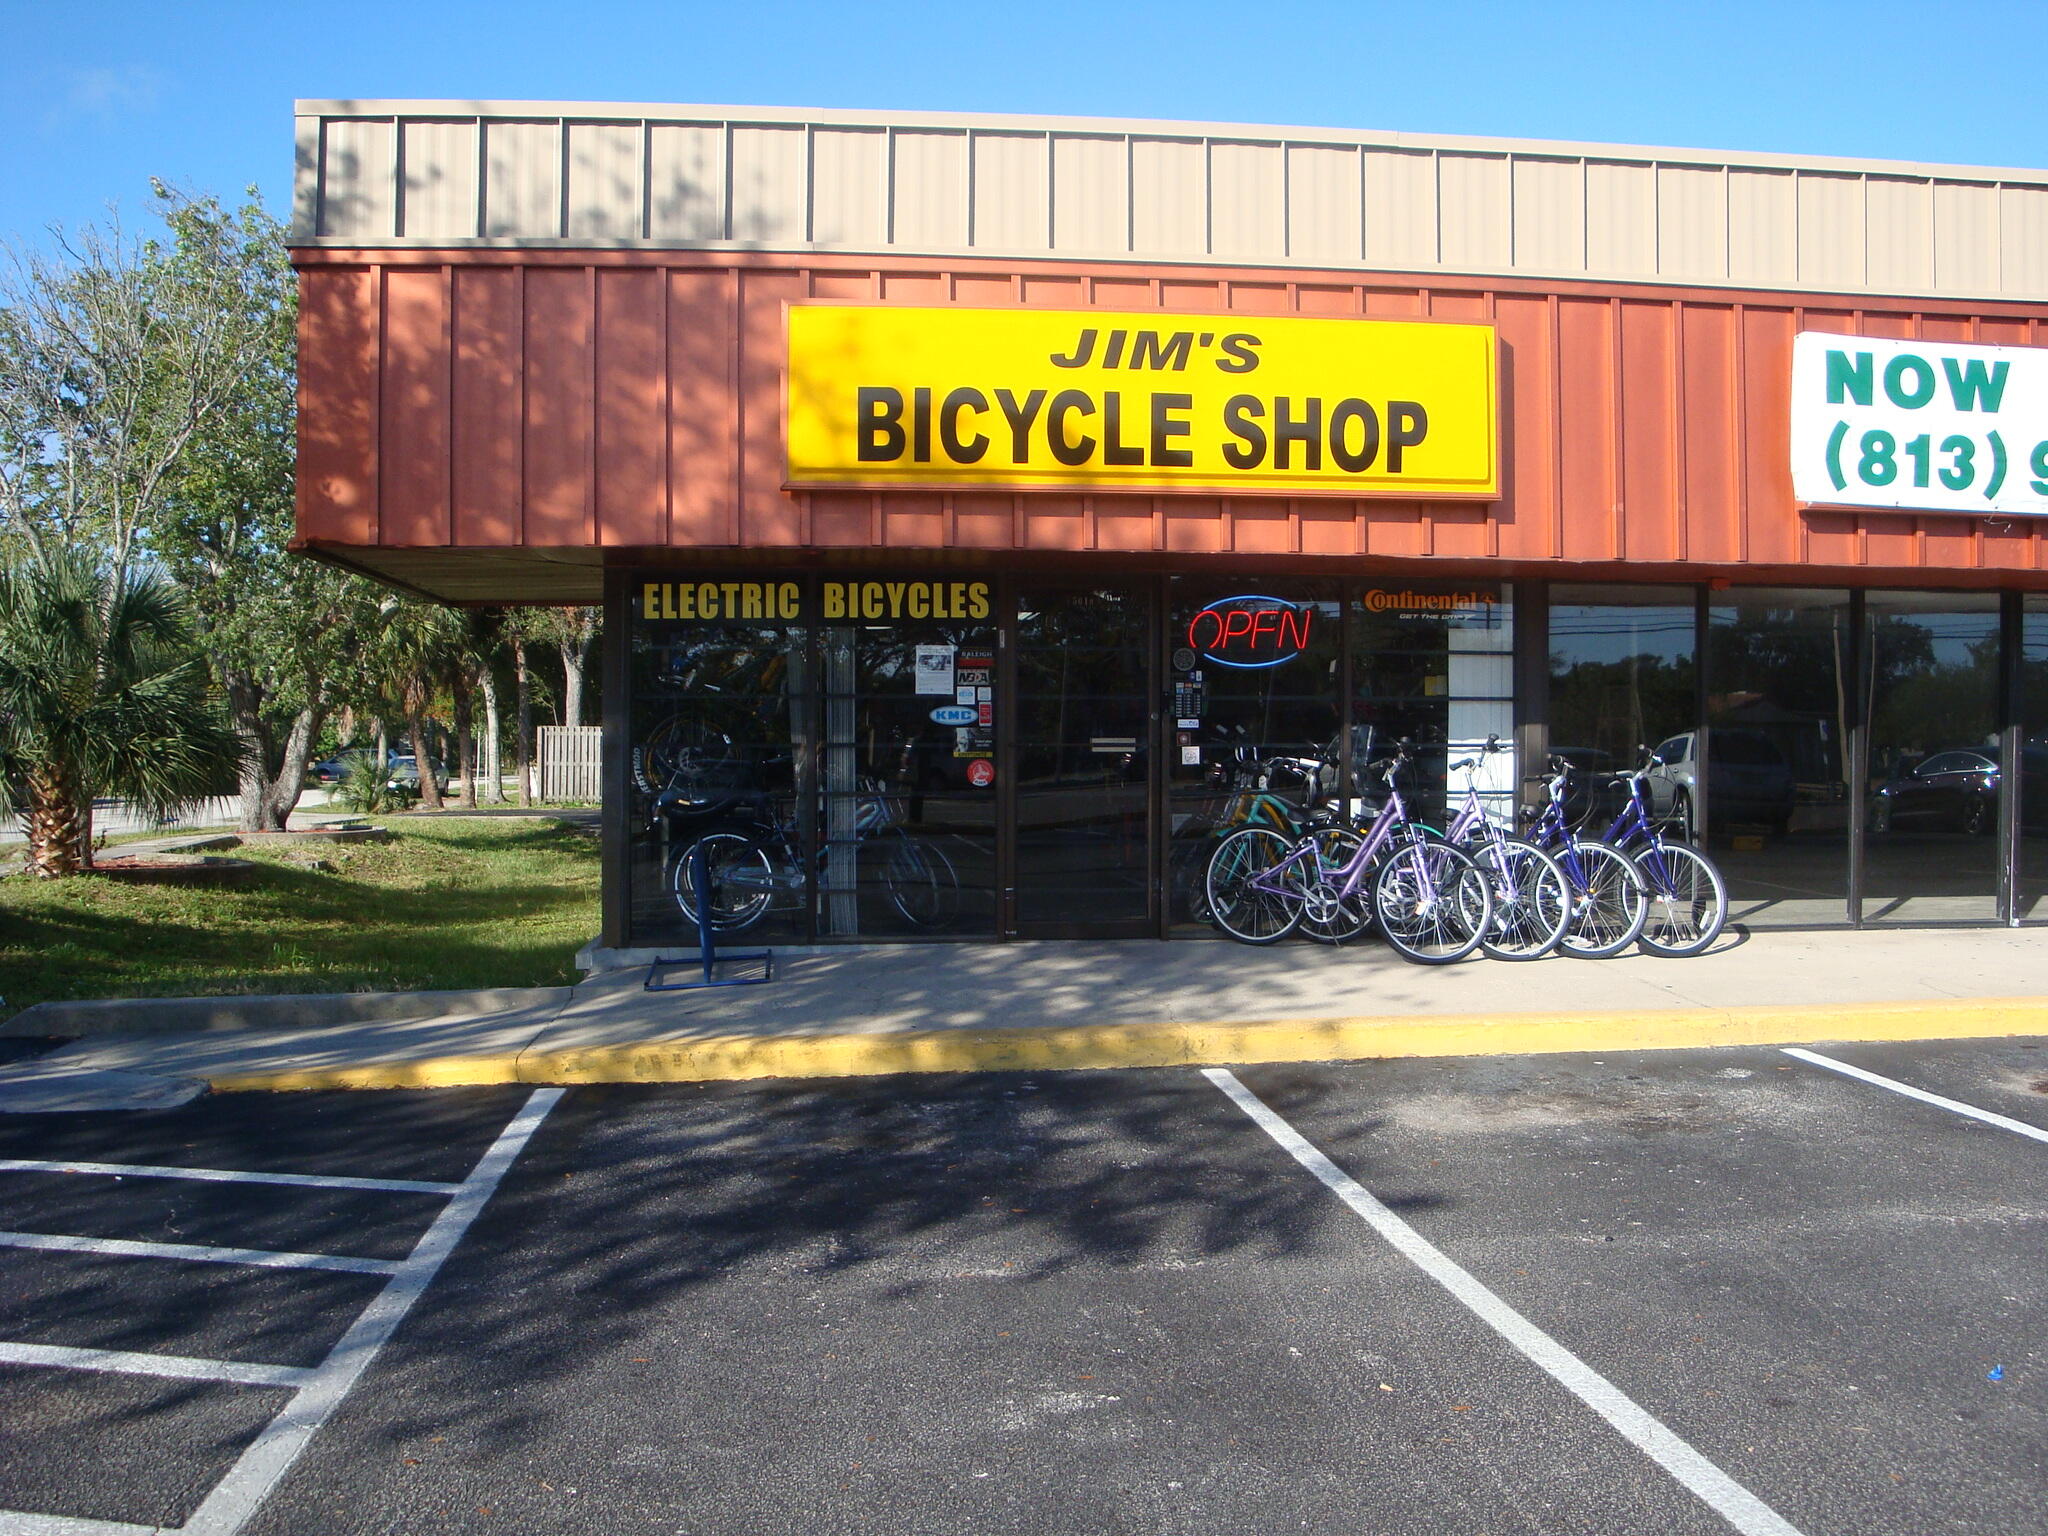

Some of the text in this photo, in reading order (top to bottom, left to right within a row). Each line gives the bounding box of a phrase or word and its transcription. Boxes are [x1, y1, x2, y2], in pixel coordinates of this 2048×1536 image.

[1050, 329, 1262, 374] JIM'S
[1825, 350, 2011, 413] NOW
[857, 386, 1429, 474] BICYCLE SHOP
[1826, 420, 2008, 501] (813)
[643, 582, 990, 619] ELECTRIC BICYCLES
[1364, 589, 1477, 612] Continental
[935, 710, 972, 720] KMC
